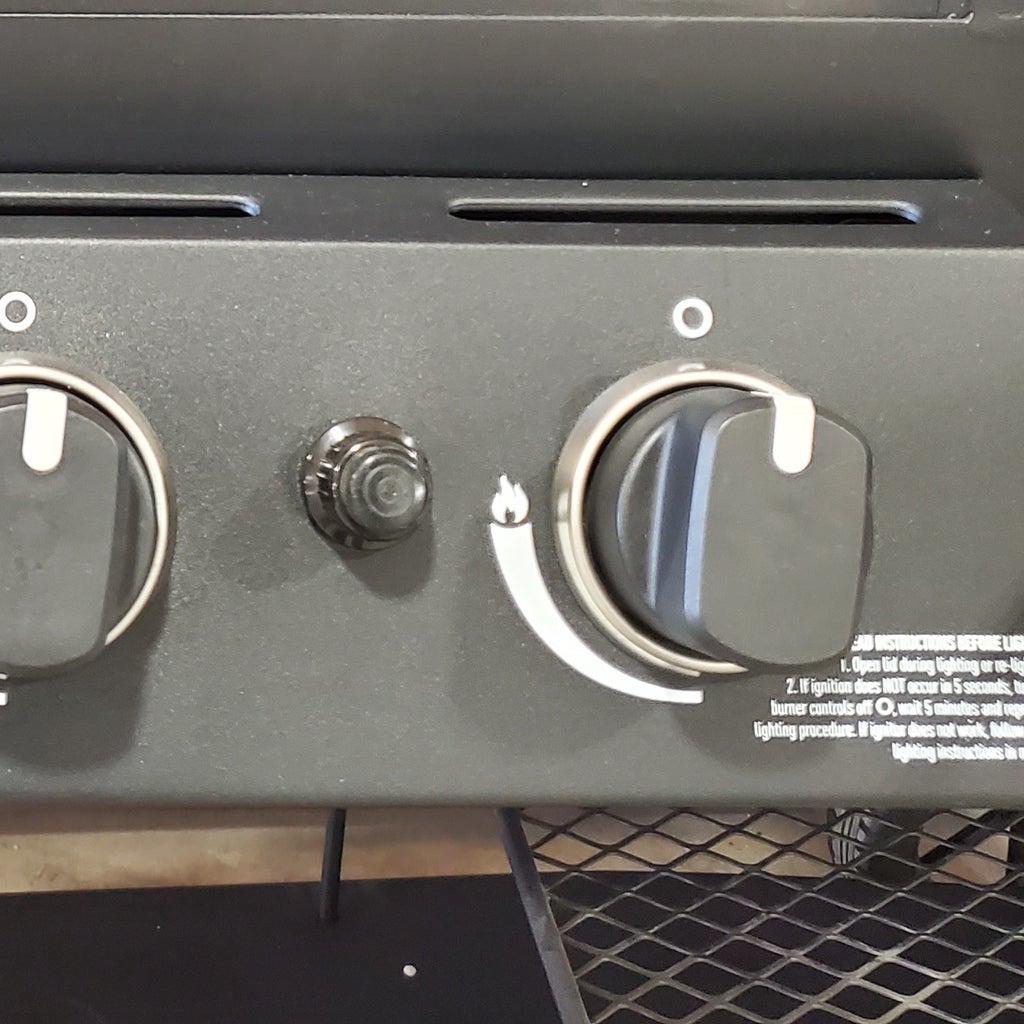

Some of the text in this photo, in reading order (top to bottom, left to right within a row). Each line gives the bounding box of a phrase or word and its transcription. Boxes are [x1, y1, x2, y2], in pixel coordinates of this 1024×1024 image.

[875, 634, 957, 652] INSTRUCTIONS
[957, 634, 1003, 652] BEFORE
[852, 656, 881, 675] Open
[881, 656, 899, 673] lid
[899, 656, 936, 677] during
[936, 656, 980, 677] lighting
[980, 659, 994, 673] or
[786, 678, 798, 695] 2.
[799, 678, 811, 695] If
[811, 678, 853, 698] ignition
[854, 678, 882, 695] does
[882, 678, 907, 695] NOT
[907, 681, 939, 695] occur
[939, 678, 953, 695] in
[953, 678, 963, 695] 5
[770, 699, 808, 716] burner
[809, 699, 856, 716] controls
[856, 699, 874, 716] off
[897, 699, 923, 716] wait
[923, 699, 934, 716] 5
[934, 699, 980, 716] minutes
[980, 699, 1003, 716] and
[753, 721, 797, 742] lighting
[798, 721, 857, 742] procedure.
[858, 721, 869, 738] If
[907, 721, 936, 738] does
[936, 721, 957, 738] not
[891, 742, 937, 763] lighting
[937, 743, 1004, 760] instructions
[1004, 743, 1018, 760] in
